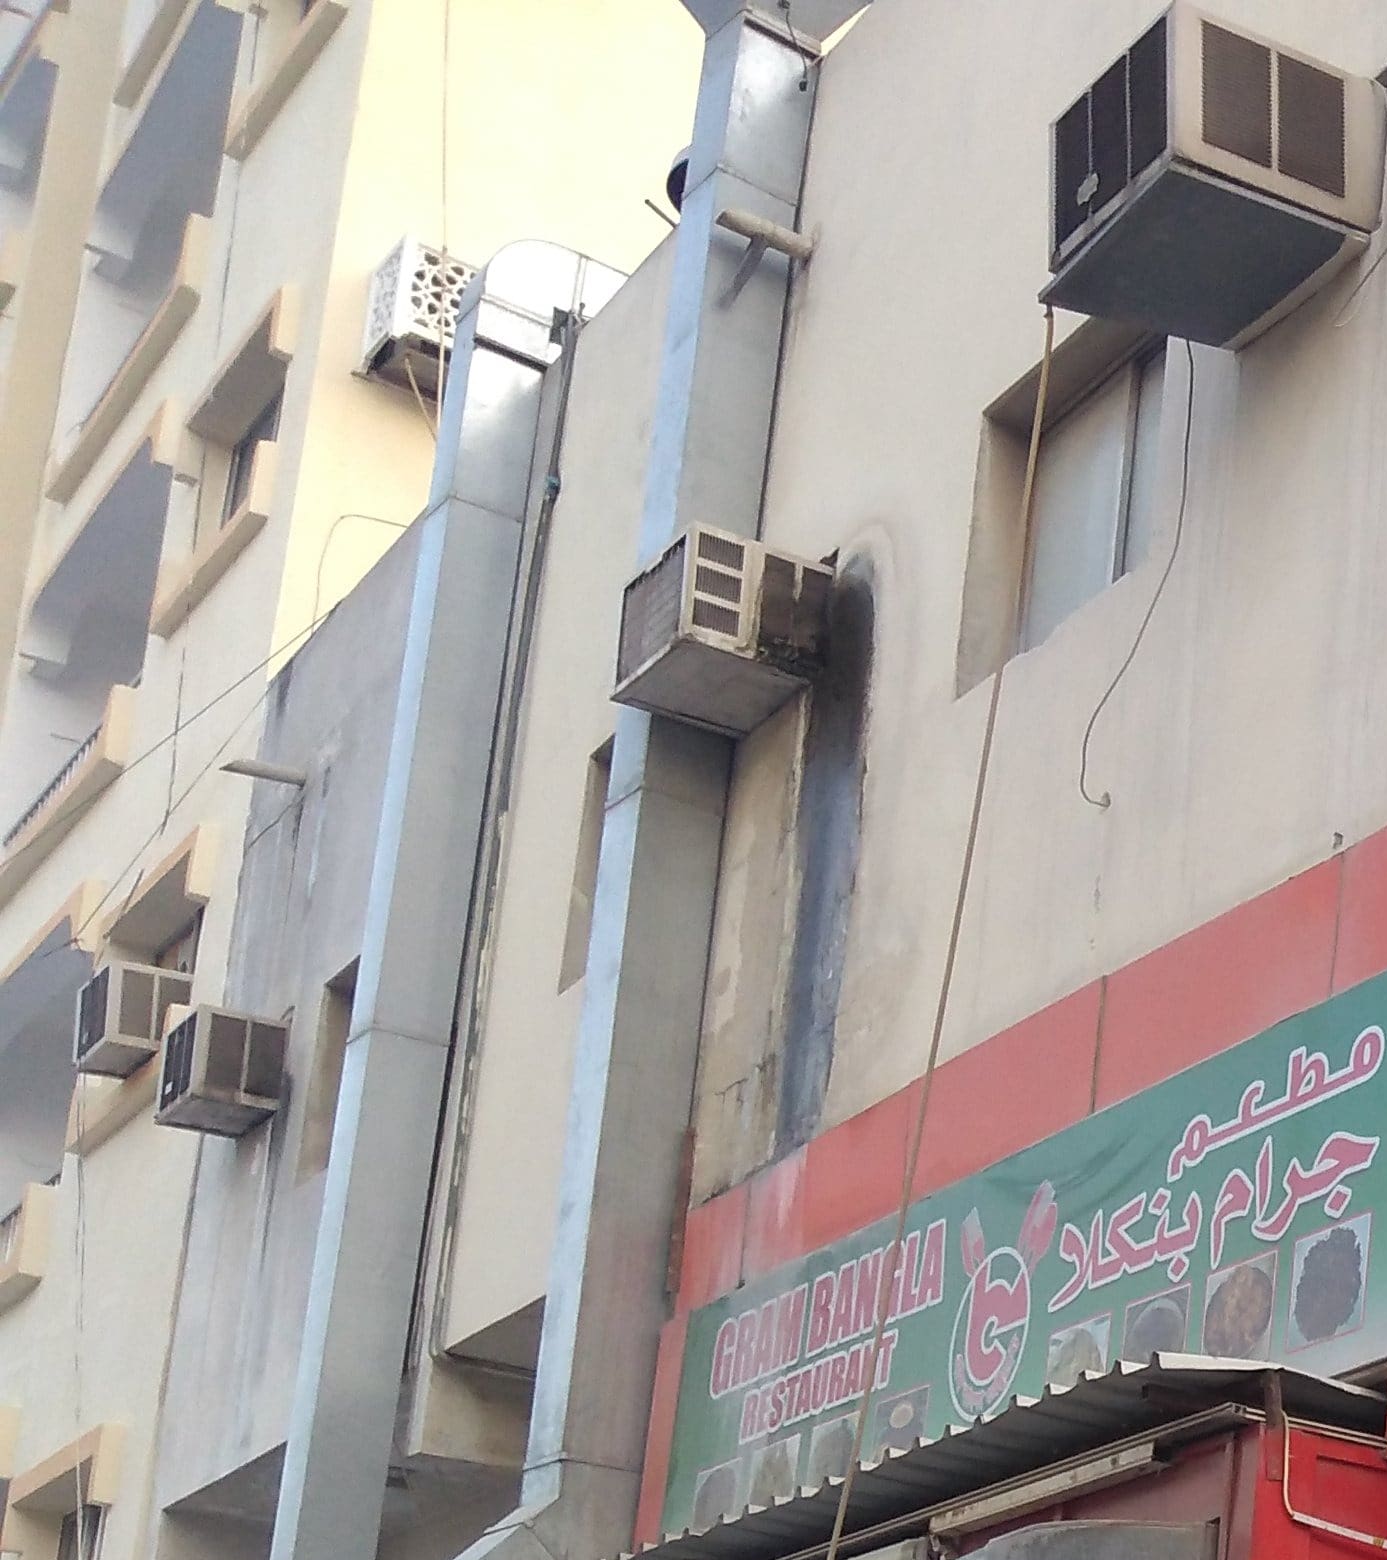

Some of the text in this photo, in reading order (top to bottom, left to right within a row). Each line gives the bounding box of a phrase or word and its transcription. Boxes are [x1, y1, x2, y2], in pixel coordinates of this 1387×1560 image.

[1167, 1025, 1385, 1182] مطعم
[1047, 1131, 1380, 1314] جرام بنكلا
[710, 1283, 808, 1399] GRAM
